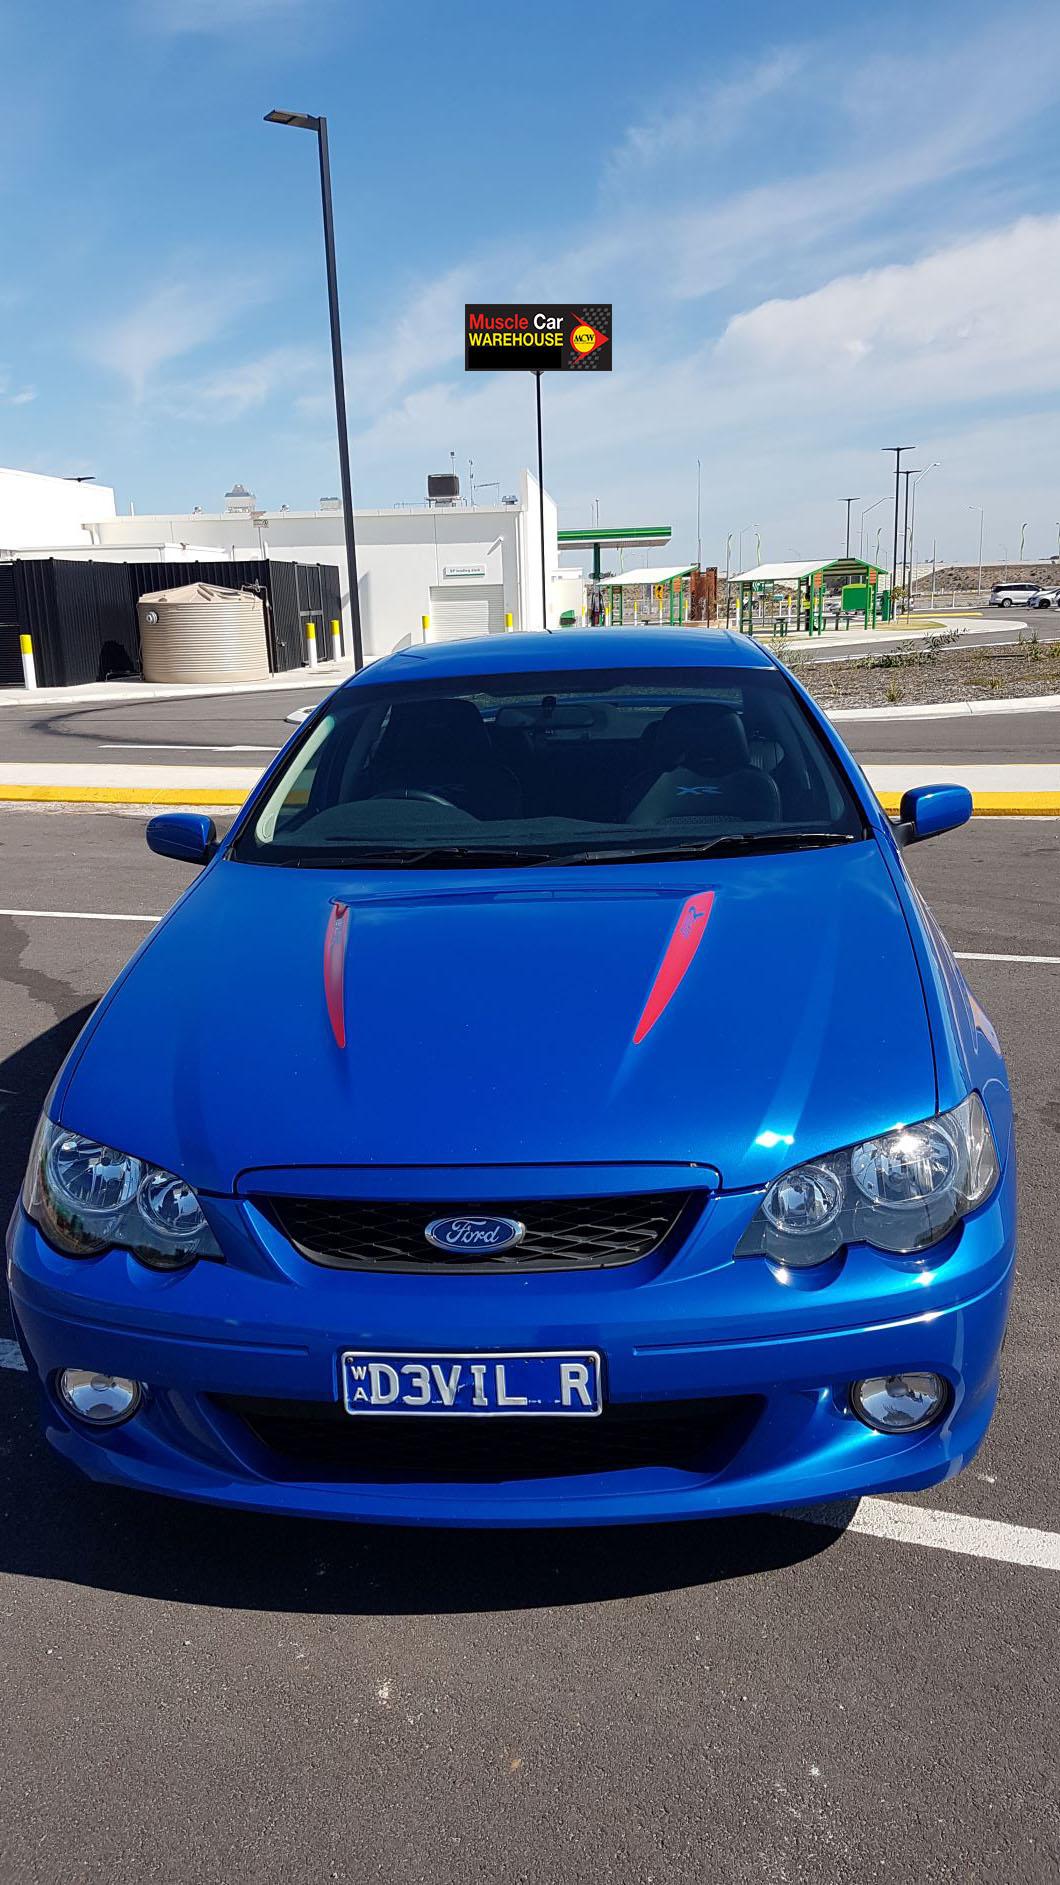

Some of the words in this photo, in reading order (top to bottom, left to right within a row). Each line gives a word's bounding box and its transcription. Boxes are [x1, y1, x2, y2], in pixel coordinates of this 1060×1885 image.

[469, 313, 529, 330] Muscle
[533, 313, 564, 330] Car
[468, 332, 564, 347] WAREHOUSE
[445, 1219, 501, 1243] Ford
[368, 1363, 528, 1406] D3VIL
[560, 1363, 592, 1406] R
